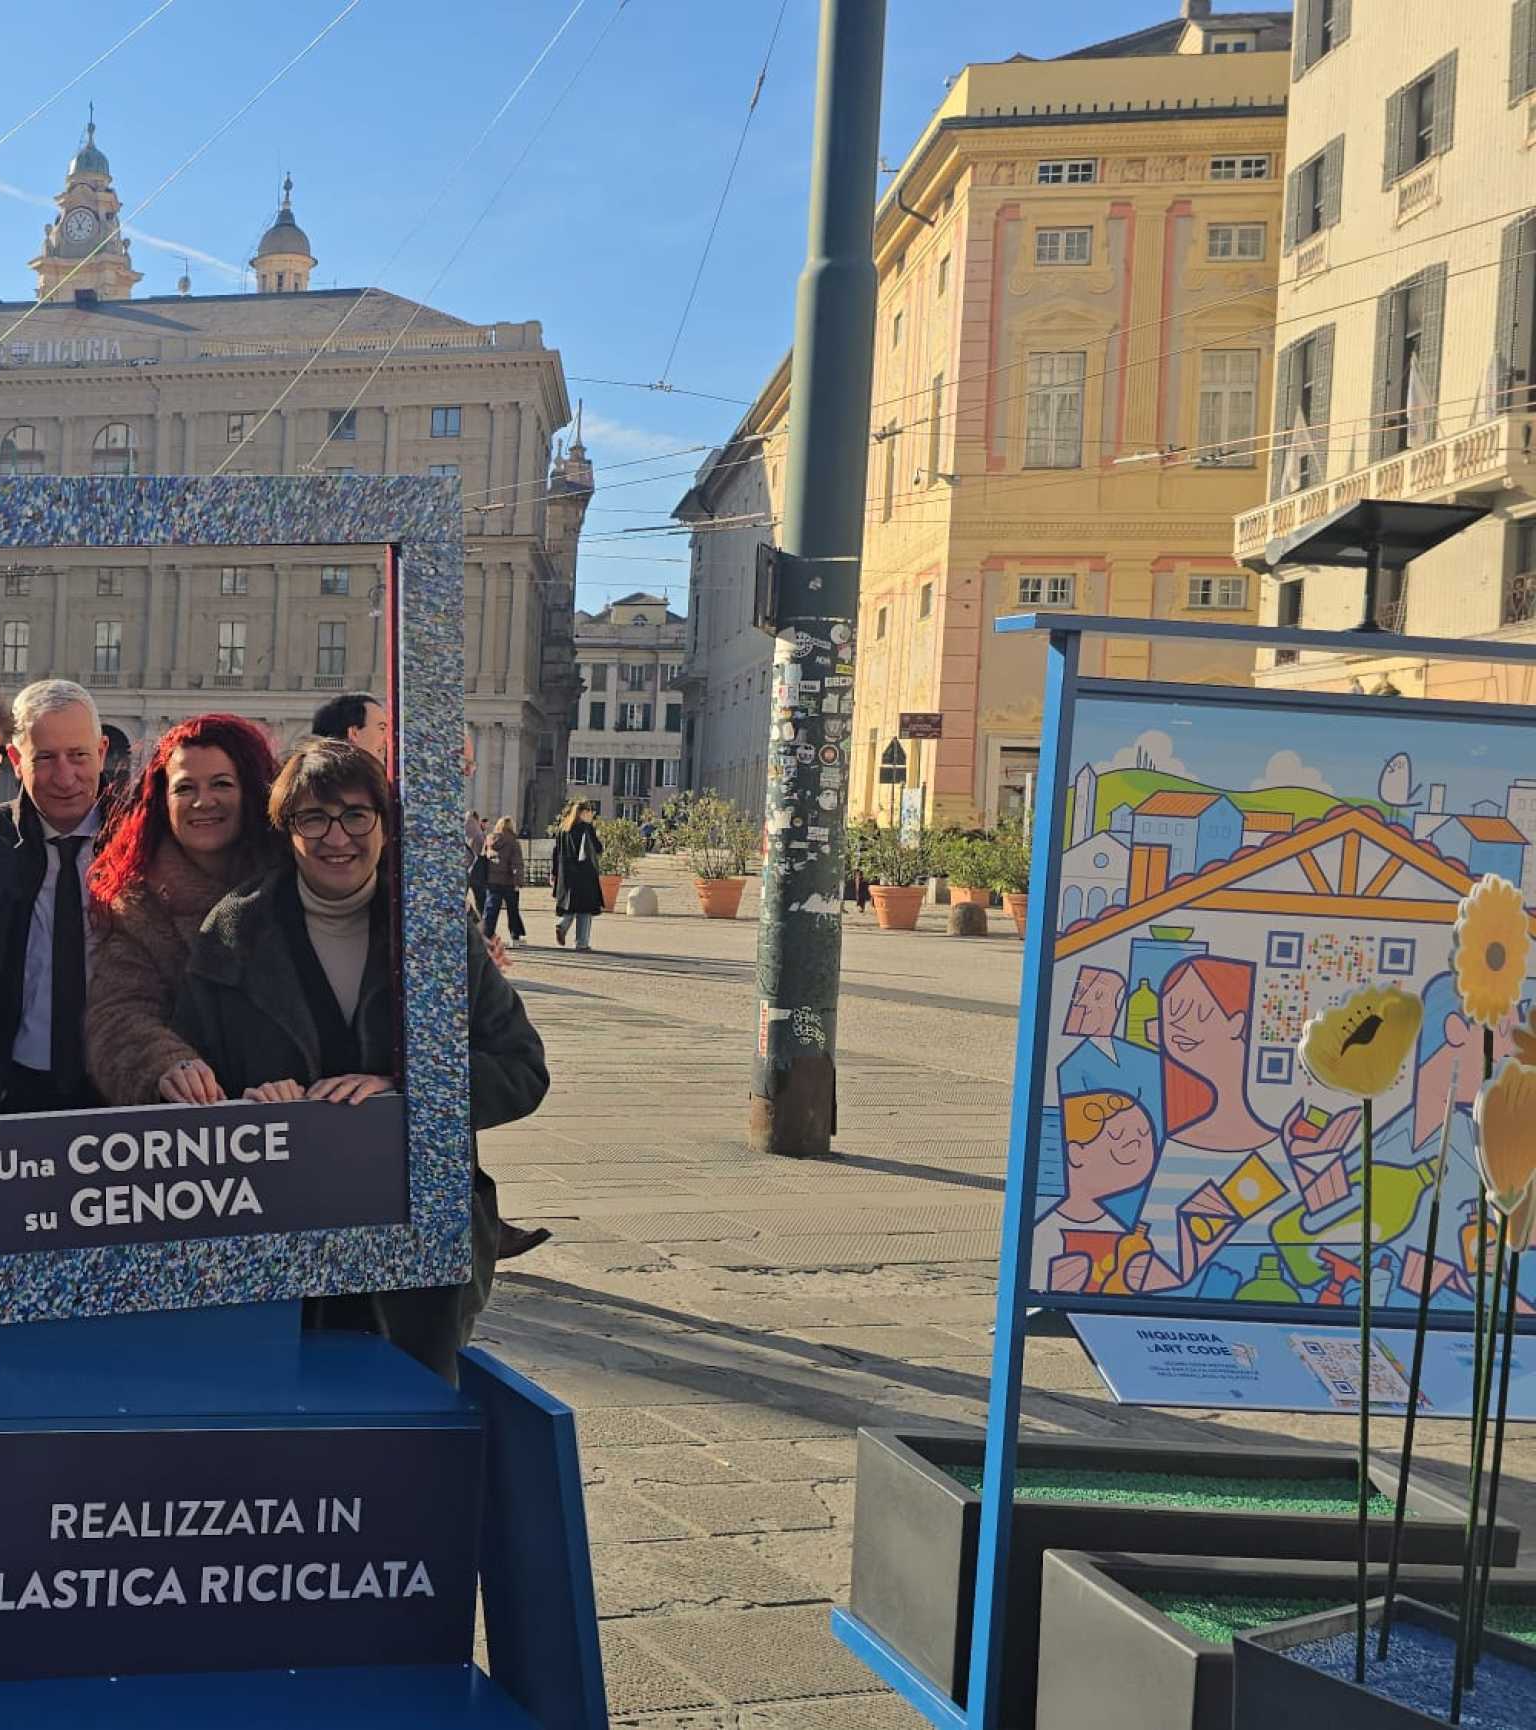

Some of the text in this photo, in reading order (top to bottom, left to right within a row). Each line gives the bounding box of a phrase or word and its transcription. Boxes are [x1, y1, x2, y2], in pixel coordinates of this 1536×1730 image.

[68, 1122, 290, 1175] CORNICE
[25, 1176, 263, 1232] su GENOVA
[1136, 1329, 1224, 1343] INQUADRA
[1187, 1345, 1233, 1356] CODE
[50, 1497, 361, 1539] REALIZZATA IN
[200, 1560, 435, 1604] RICICLATA
